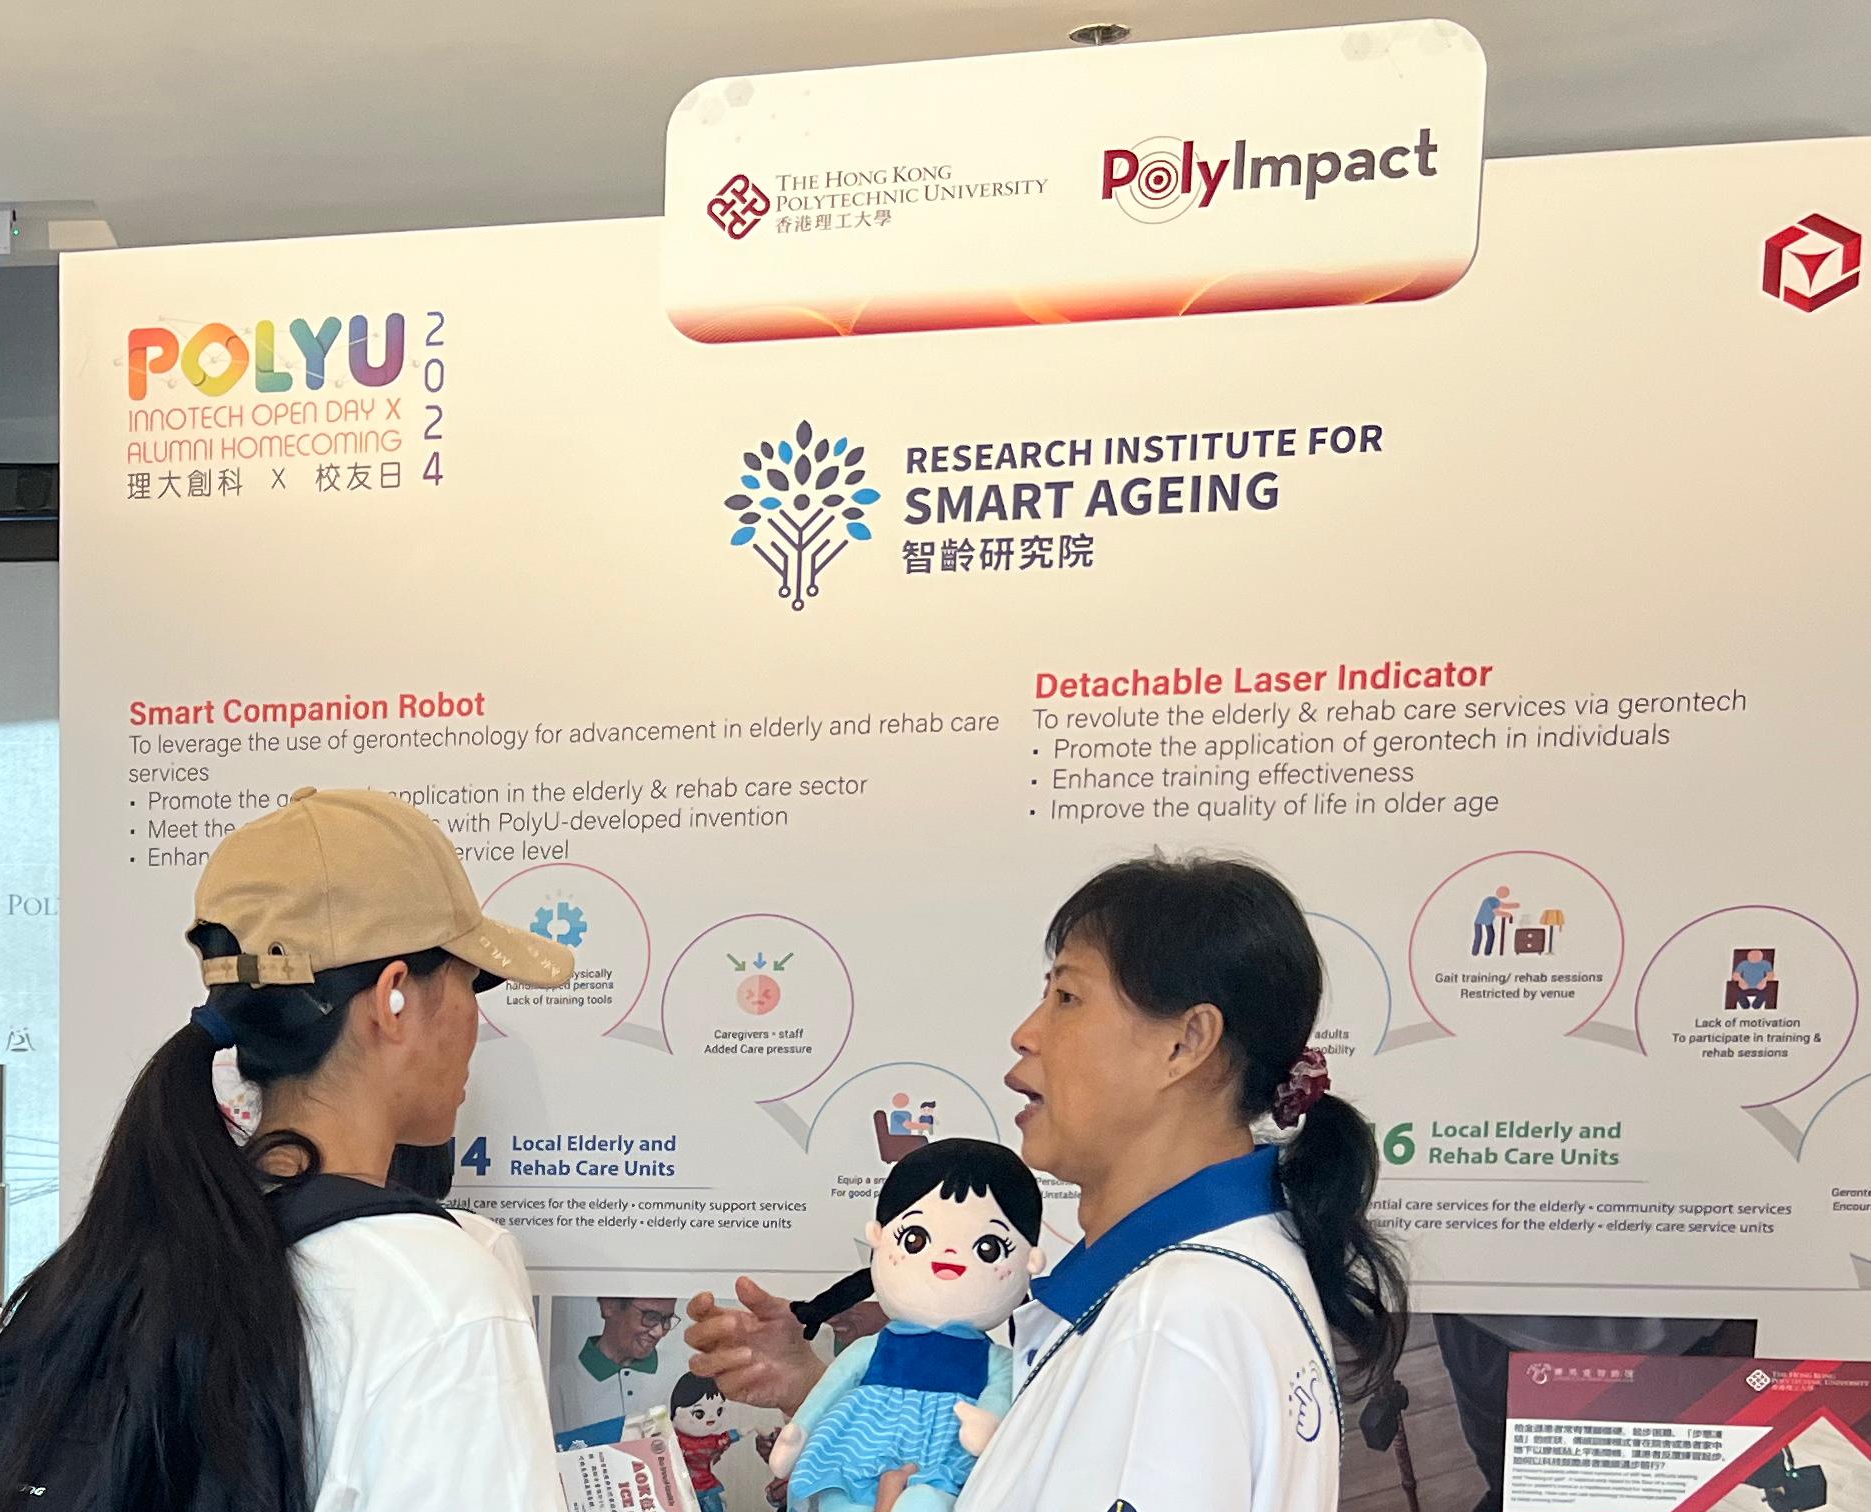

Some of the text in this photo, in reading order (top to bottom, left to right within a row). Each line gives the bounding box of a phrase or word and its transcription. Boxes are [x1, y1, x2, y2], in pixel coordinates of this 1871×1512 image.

[776, 165, 952, 192] THE HONG KONG
[1101, 129, 1438, 209] PolyImpact
[776, 178, 1048, 212] POLYTECHNIC UNIVERSITY
[776, 209, 892, 234] 香港理工大學
[128, 313, 404, 400] POLYU
[129, 404, 243, 432] INNOTECH
[251, 401, 317, 426] OPEN
[327, 398, 375, 422] DAY
[128, 430, 402, 464] ALUMNI HOMECOMING
[906, 424, 1383, 473] RESEARCH INSTITUTE FOR
[127, 466, 242, 499] 理大創科
[316, 461, 400, 492] 校友日
[904, 471, 1279, 525] SMART AGEING
[902, 533, 1095, 574] 智齡研究院
[1036, 661, 1493, 699] Detachable Laser Indicator
[129, 692, 485, 728] Smart Companion Robot
[1032, 689, 1747, 729] To revolute the elderly & rehab care services via gerontech
[129, 712, 1000, 758] To leverage the use of gerontechnology for advancement in elderly and rehab care
[1054, 723, 1670, 760] Promote the application of gerontech in individuals
[128, 763, 209, 784] services
[1053, 762, 1414, 791] Enhance training effectiveness
[148, 791, 232, 811] Promote
[238, 789, 270, 809] the
[507, 783, 525, 802] in
[532, 782, 565, 803] the
[572, 778, 643, 804] elderly
[650, 779, 667, 800] &
[675, 777, 737, 799] rehab
[745, 778, 792, 797] care
[798, 776, 869, 795] sector
[1051, 791, 1499, 824] Improve the quality of life in older age
[148, 820, 198, 839] Meet
[448, 812, 491, 834] with
[499, 808, 682, 837] PolyU-developed
[689, 807, 789, 829] invention
[148, 839, 569, 866] Enhan ervice level
[8, 893, 60, 916] POL
[1435, 973, 1458, 983] Gait
[1514, 972, 1547, 982] rehab
[1551, 972, 1603, 982] sessions
[1460, 988, 1575, 1000] Restricted by venue
[714, 1029, 804, 1041] Caregivers staff
[1695, 1018, 1800, 1028] Lack of motivation
[704, 1044, 812, 1055] Added Care pressure
[1672, 1033, 1822, 1044] To participate in training &
[1702, 1048, 1788, 1058] rehab sessions
[513, 1135, 676, 1155] Local Elderly and
[1432, 1121, 1622, 1143] Local Elderly and
[511, 1160, 675, 1177] Rehab Care Units
[1429, 1148, 1619, 1166] Rehab Care Units
[474, 1199, 497, 1209] care
[500, 1199, 545, 1209] services
[548, 1198, 564, 1209] for
[567, 1199, 586, 1209] the
[588, 1199, 629, 1212] elderly
[638, 1200, 706, 1213] community
[709, 1200, 757, 1213] support
[759, 1201, 807, 1212] services
